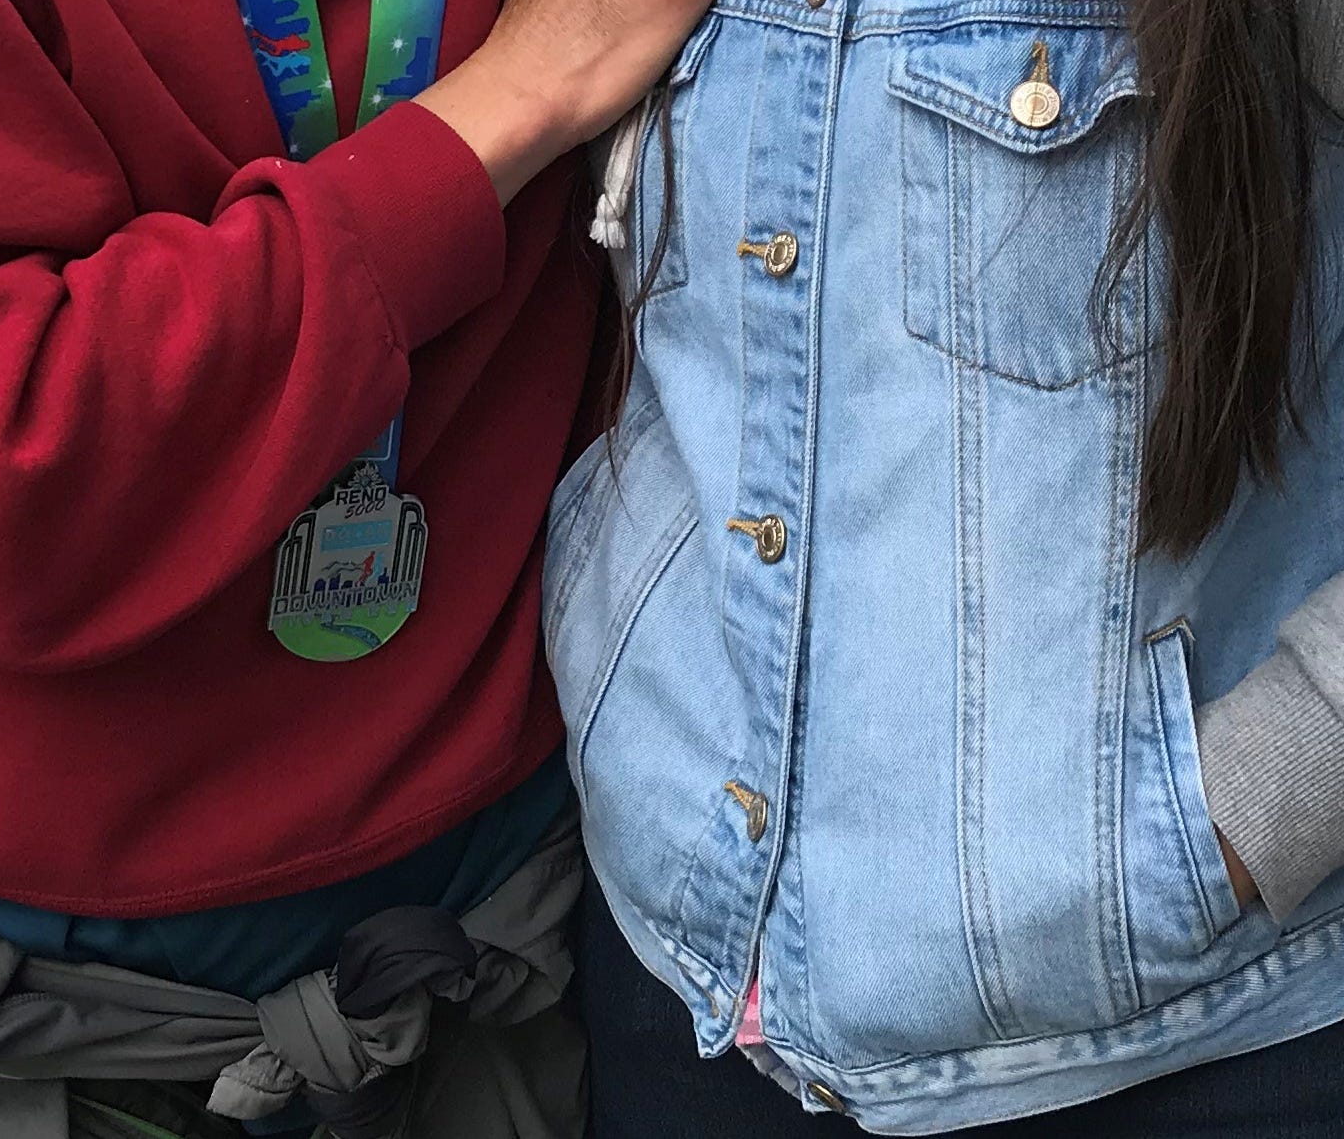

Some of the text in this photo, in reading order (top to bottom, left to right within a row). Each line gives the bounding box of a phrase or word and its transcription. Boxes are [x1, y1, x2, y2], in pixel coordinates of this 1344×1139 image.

[336, 487, 387, 506] RENO
[344, 500, 386, 519] 5000
[273, 583, 418, 616] DOWNTOWN
